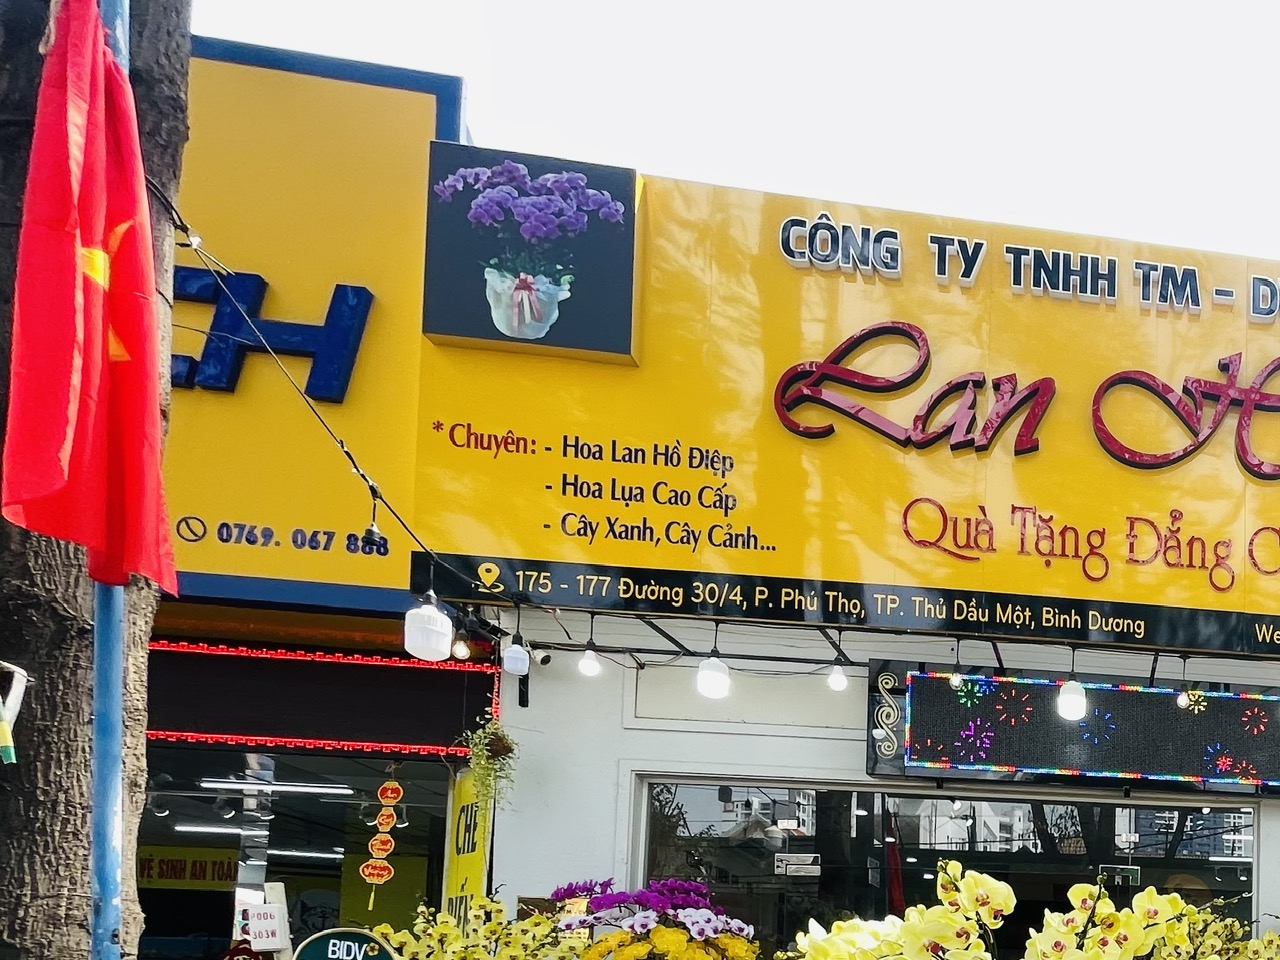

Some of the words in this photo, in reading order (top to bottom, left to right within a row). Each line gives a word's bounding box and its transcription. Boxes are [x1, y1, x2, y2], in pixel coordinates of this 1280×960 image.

[780, 212, 900, 274] CÔNG
[928, 233, 987, 285] TY
[1005, 244, 1118, 302] TNHH
[1134, 260, 1202, 313] TM
[774, 321, 1056, 458] Lan
[449, 423, 537, 458] Chuyên:
[562, 435, 603, 460] Hoa
[611, 440, 646, 465] Lan
[653, 439, 682, 468] Hồ
[688, 447, 734, 478] Điệp
[562, 474, 603, 499] Hoa
[611, 478, 645, 508] Lụa
[652, 481, 691, 507] Cao
[697, 483, 737, 517] Cấp
[217, 522, 281, 548] 0769.
[292, 528, 336, 551] 067
[561, 512, 600, 546] Cây
[604, 516, 661, 548] Xanh,
[665, 521, 701, 553] Cây
[708, 524, 776, 551] Cảnh...
[902, 497, 997, 562] Quà
[1010, 503, 1109, 582] Tặng
[1125, 509, 1235, 592] Đẳng
[515, 570, 552, 593] 175
[576, 574, 612, 597] 177
[618, 577, 684, 607] Đường
[691, 582, 748, 611] 30/4,
[755, 586, 773, 609] P.
[781, 590, 818, 611] Phú
[824, 590, 866, 619] Thọ,
[873, 594, 904, 617] TP.
[912, 596, 946, 620] Thủ
[954, 600, 989, 623] Dầu
[996, 602, 1036, 630] Một,
[1042, 608, 1081, 630] Bình
[1089, 611, 1146, 639] Dương
[158, 858, 187, 880] SINH
[190, 860, 207, 881] AN
[328, 939, 368, 960] BIDV
